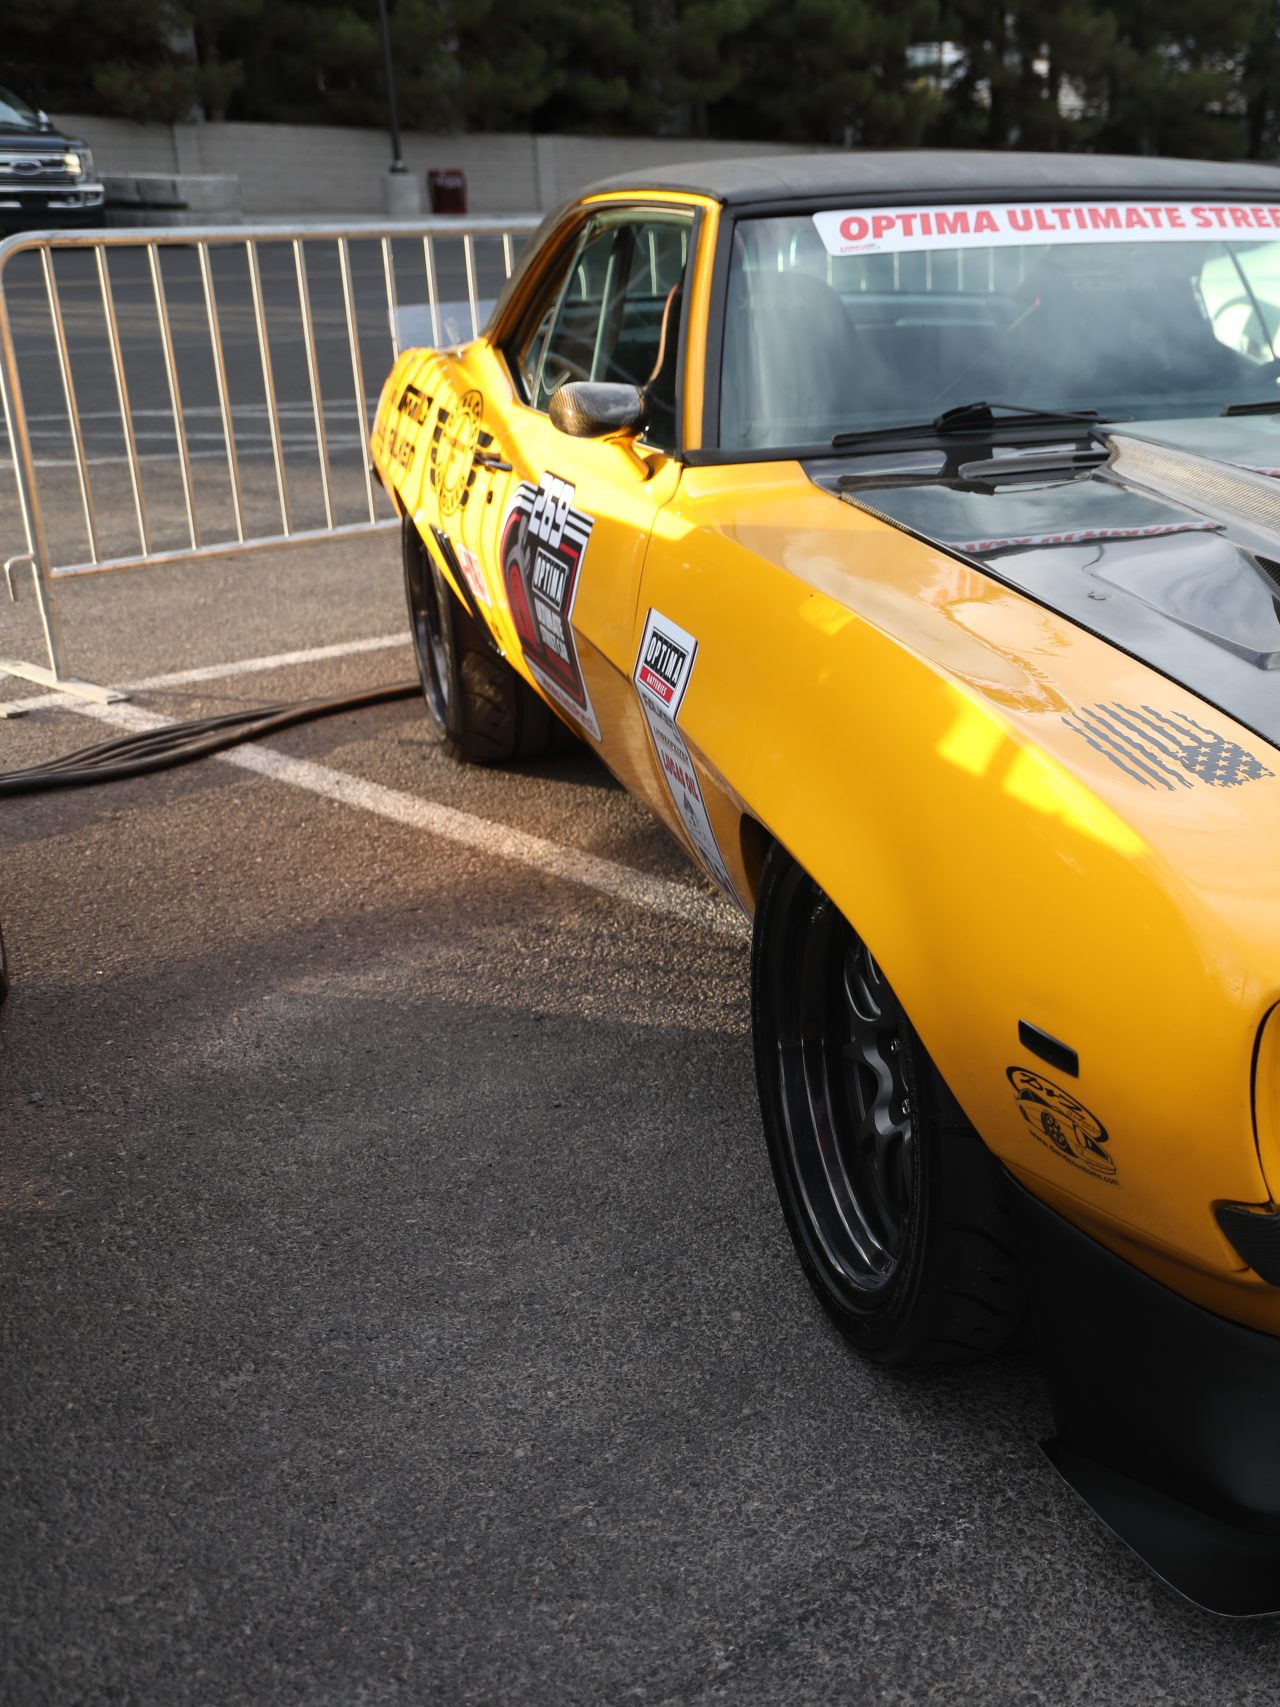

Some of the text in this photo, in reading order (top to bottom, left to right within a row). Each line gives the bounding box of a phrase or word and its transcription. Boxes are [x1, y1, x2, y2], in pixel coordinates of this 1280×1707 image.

[839, 209, 1000, 241] OPTIMA
[1006, 206, 1186, 232] ULTIMATE
[528, 471, 575, 549] 269
[533, 556, 566, 603] OPTIMA
[647, 636, 683, 684] OPTIMA
[646, 673, 667, 697] BATTERIES
